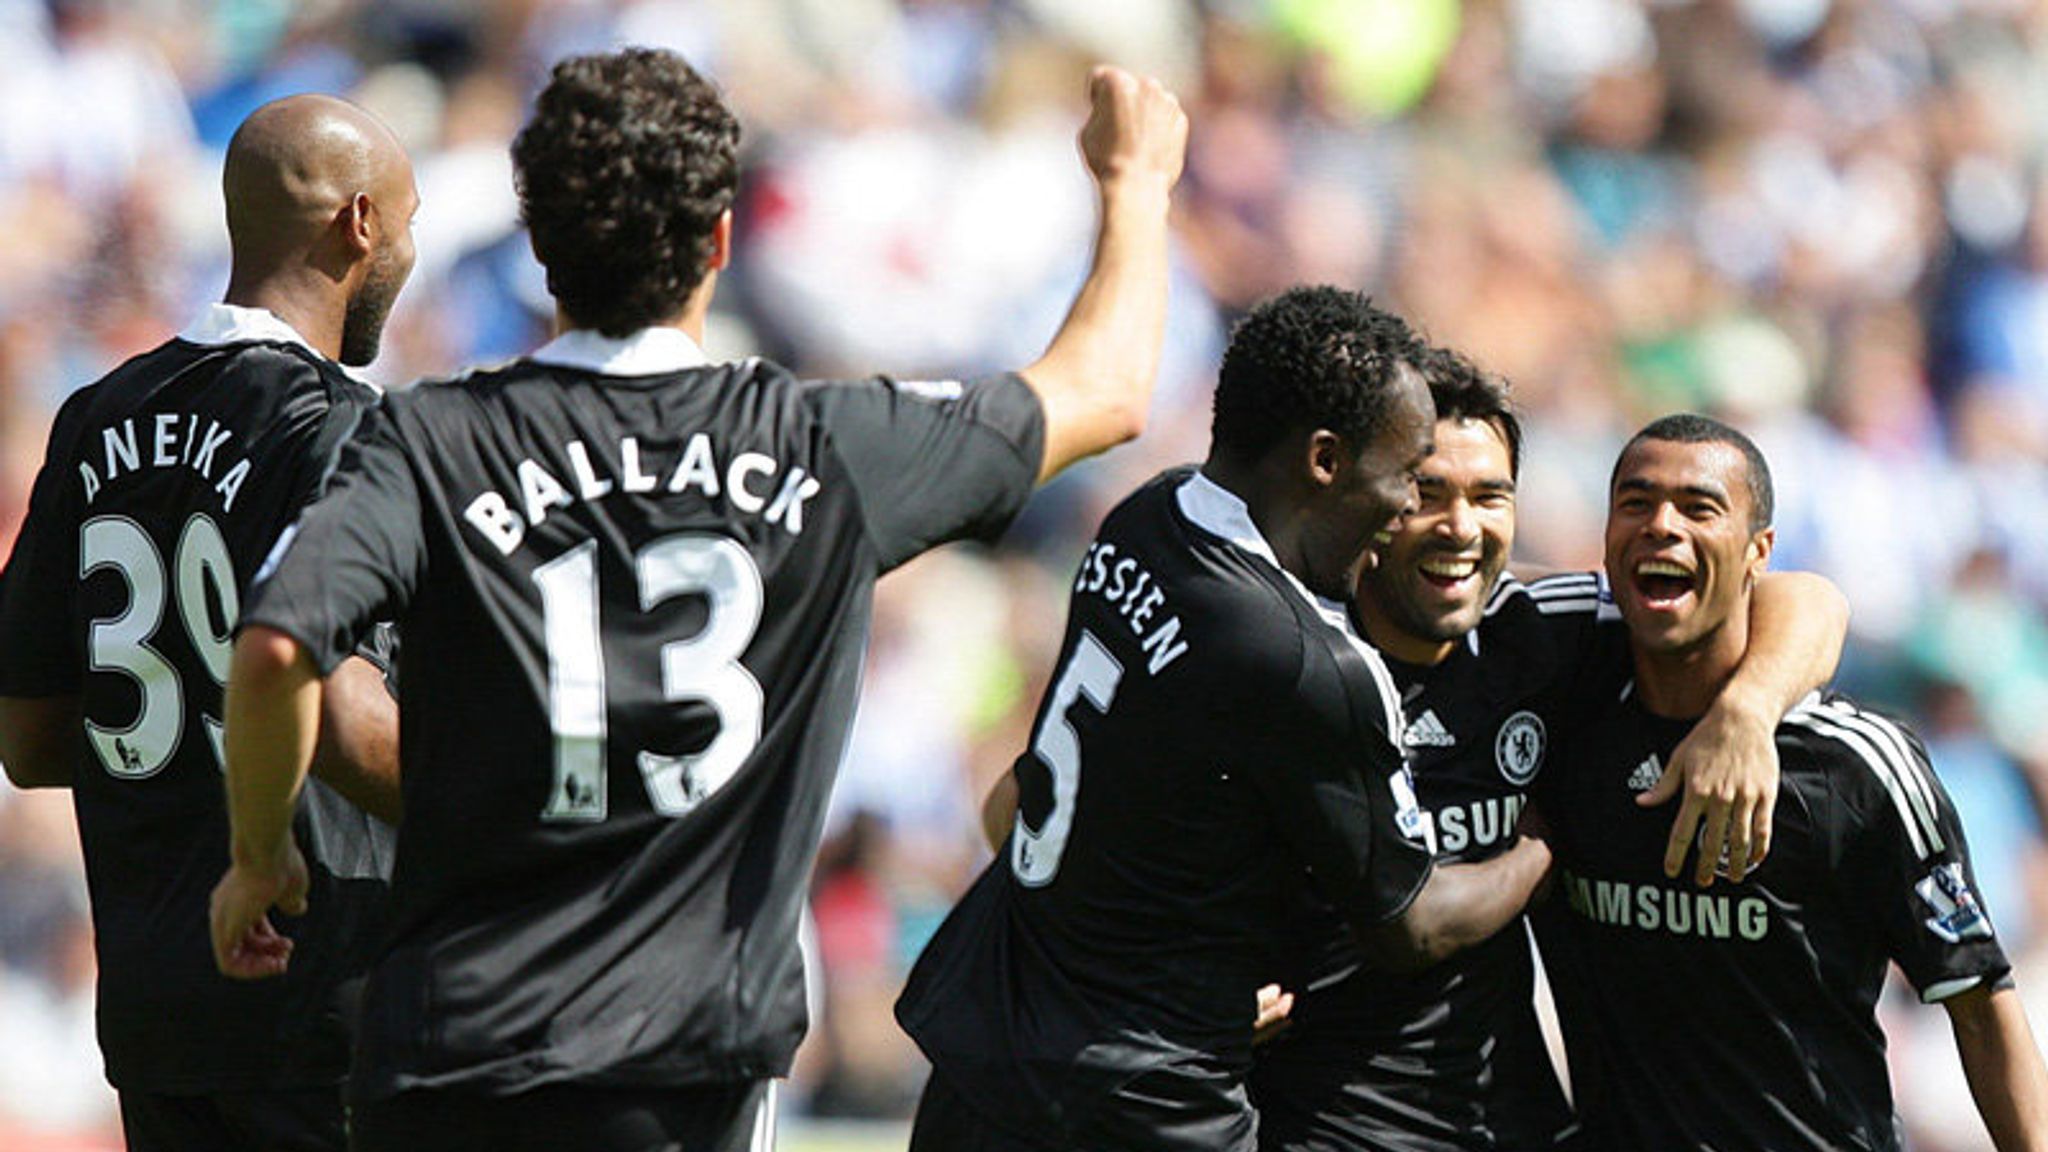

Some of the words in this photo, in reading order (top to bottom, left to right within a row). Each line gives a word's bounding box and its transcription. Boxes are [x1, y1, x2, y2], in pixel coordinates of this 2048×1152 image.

[464, 433, 820, 555] BALLACK
[78, 512, 240, 781] 39
[532, 530, 765, 824] 13
[1011, 627, 1125, 888] 5
[1564, 874, 1768, 941] AMSUNG
